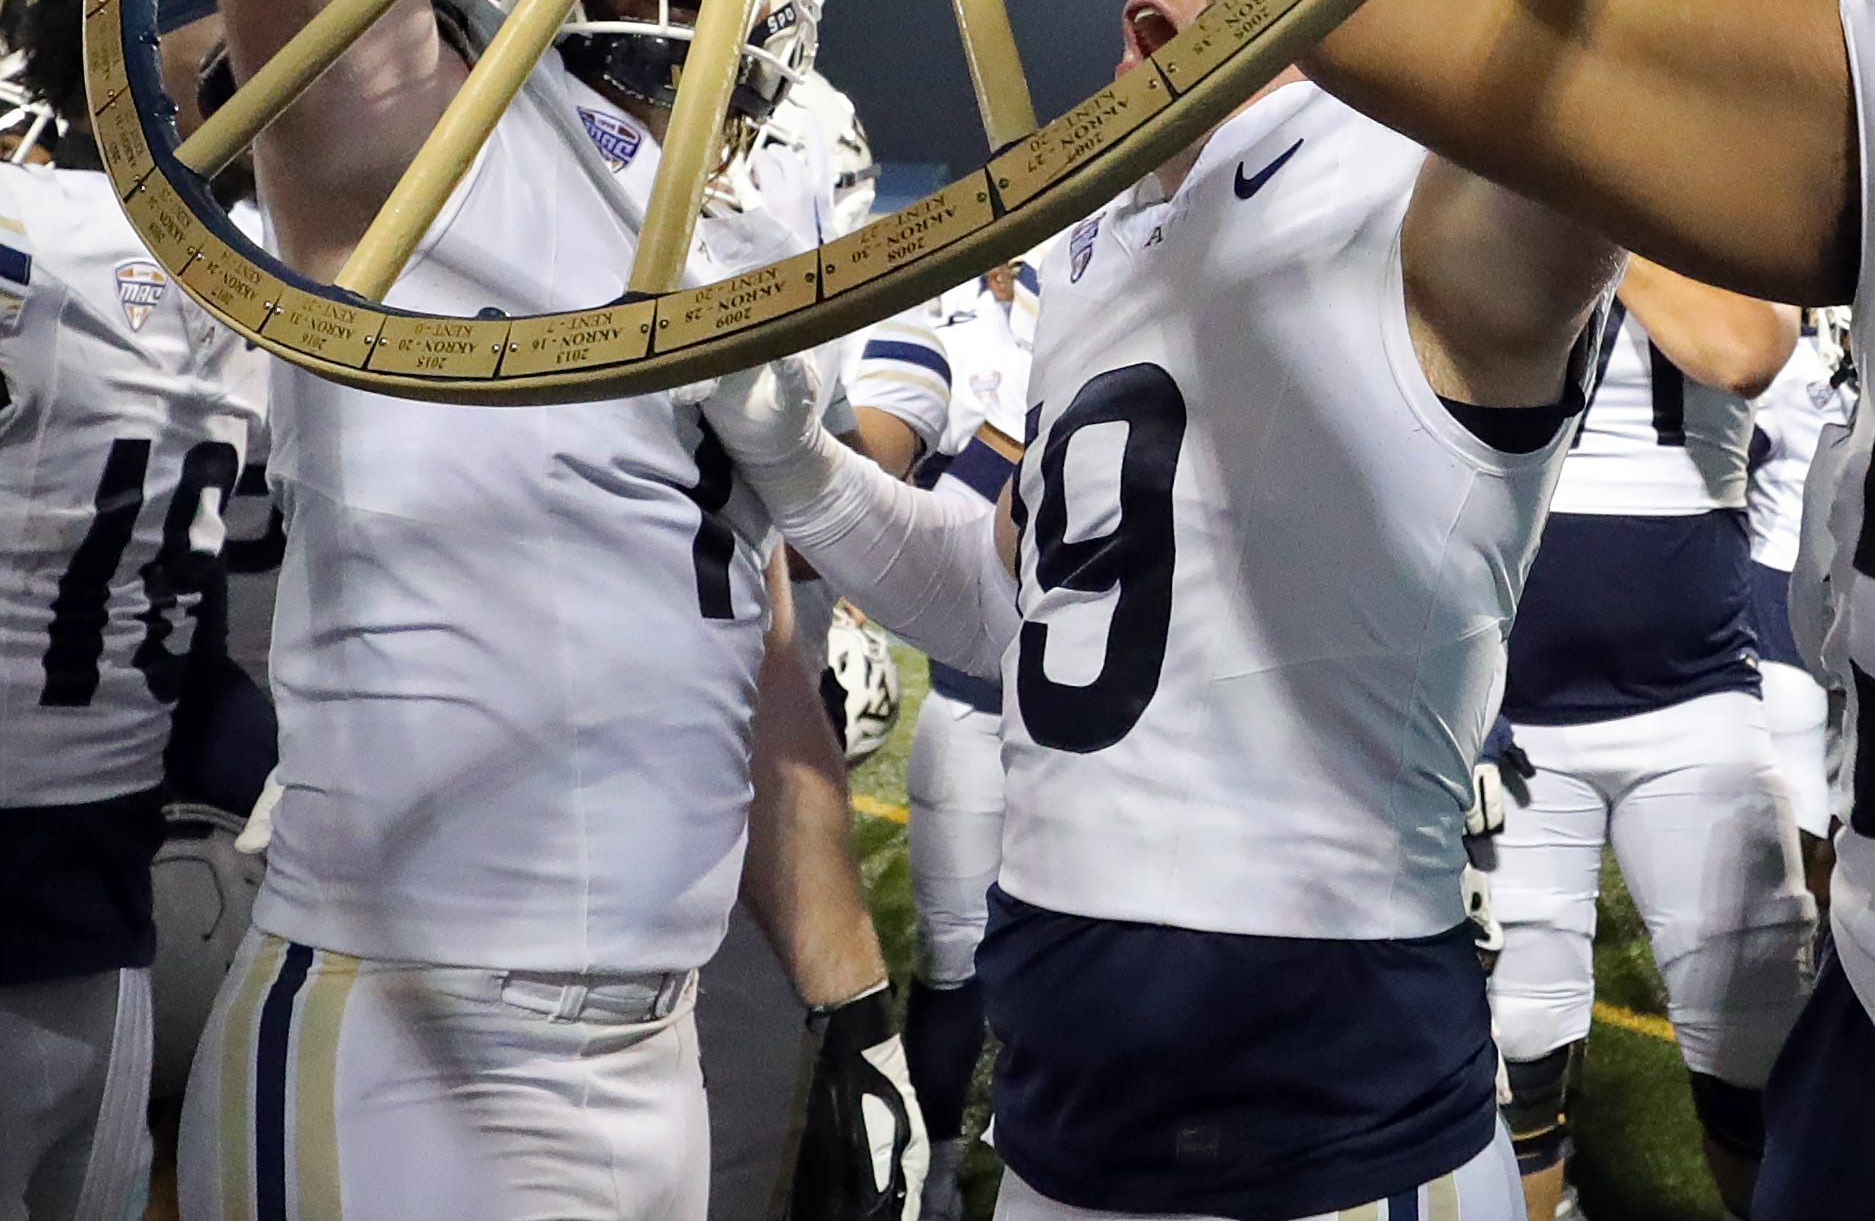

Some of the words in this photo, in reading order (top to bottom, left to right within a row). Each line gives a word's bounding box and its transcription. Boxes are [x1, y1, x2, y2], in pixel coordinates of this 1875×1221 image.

[1063, 89, 1115, 130] KENT
[1058, 95, 1131, 151] AKRON
[1028, 132, 1050, 154] 20
[1063, 130, 1105, 164] 2007
[1024, 152, 1045, 173] 27
[895, 193, 945, 228] KENT
[157, 207, 186, 247] AKRON
[860, 225, 878, 244] 27
[886, 203, 957, 248] AKRON
[1144, 226, 1163, 248] A
[851, 246, 868, 264] 30
[886, 235, 925, 264] 2008
[233, 259, 262, 288] KENT
[727, 266, 776, 293] KENT
[120, 282, 163, 303] MAC
[220, 270, 257, 303] AKRON
[695, 287, 712, 303] 20
[717, 280, 785, 312] AKRON
[288, 311, 303, 325] 31
[321, 304, 358, 323] KENT
[567, 311, 612, 330] KENT
[685, 306, 701, 323] 28
[715, 306, 751, 328] 2009
[307, 318, 355, 340] AKRON
[413, 323, 423, 334] 0
[431, 323, 473, 337] KENT
[546, 320, 555, 333] 7
[560, 326, 623, 347] AKRON
[299, 331, 327, 350] 2016
[396, 339, 413, 351] 20
[422, 340, 479, 354] AKRON
[530, 338, 547, 351] 16
[415, 355, 447, 369] 2015
[555, 347, 589, 363] 2013
[1011, 362, 1188, 754] 9
